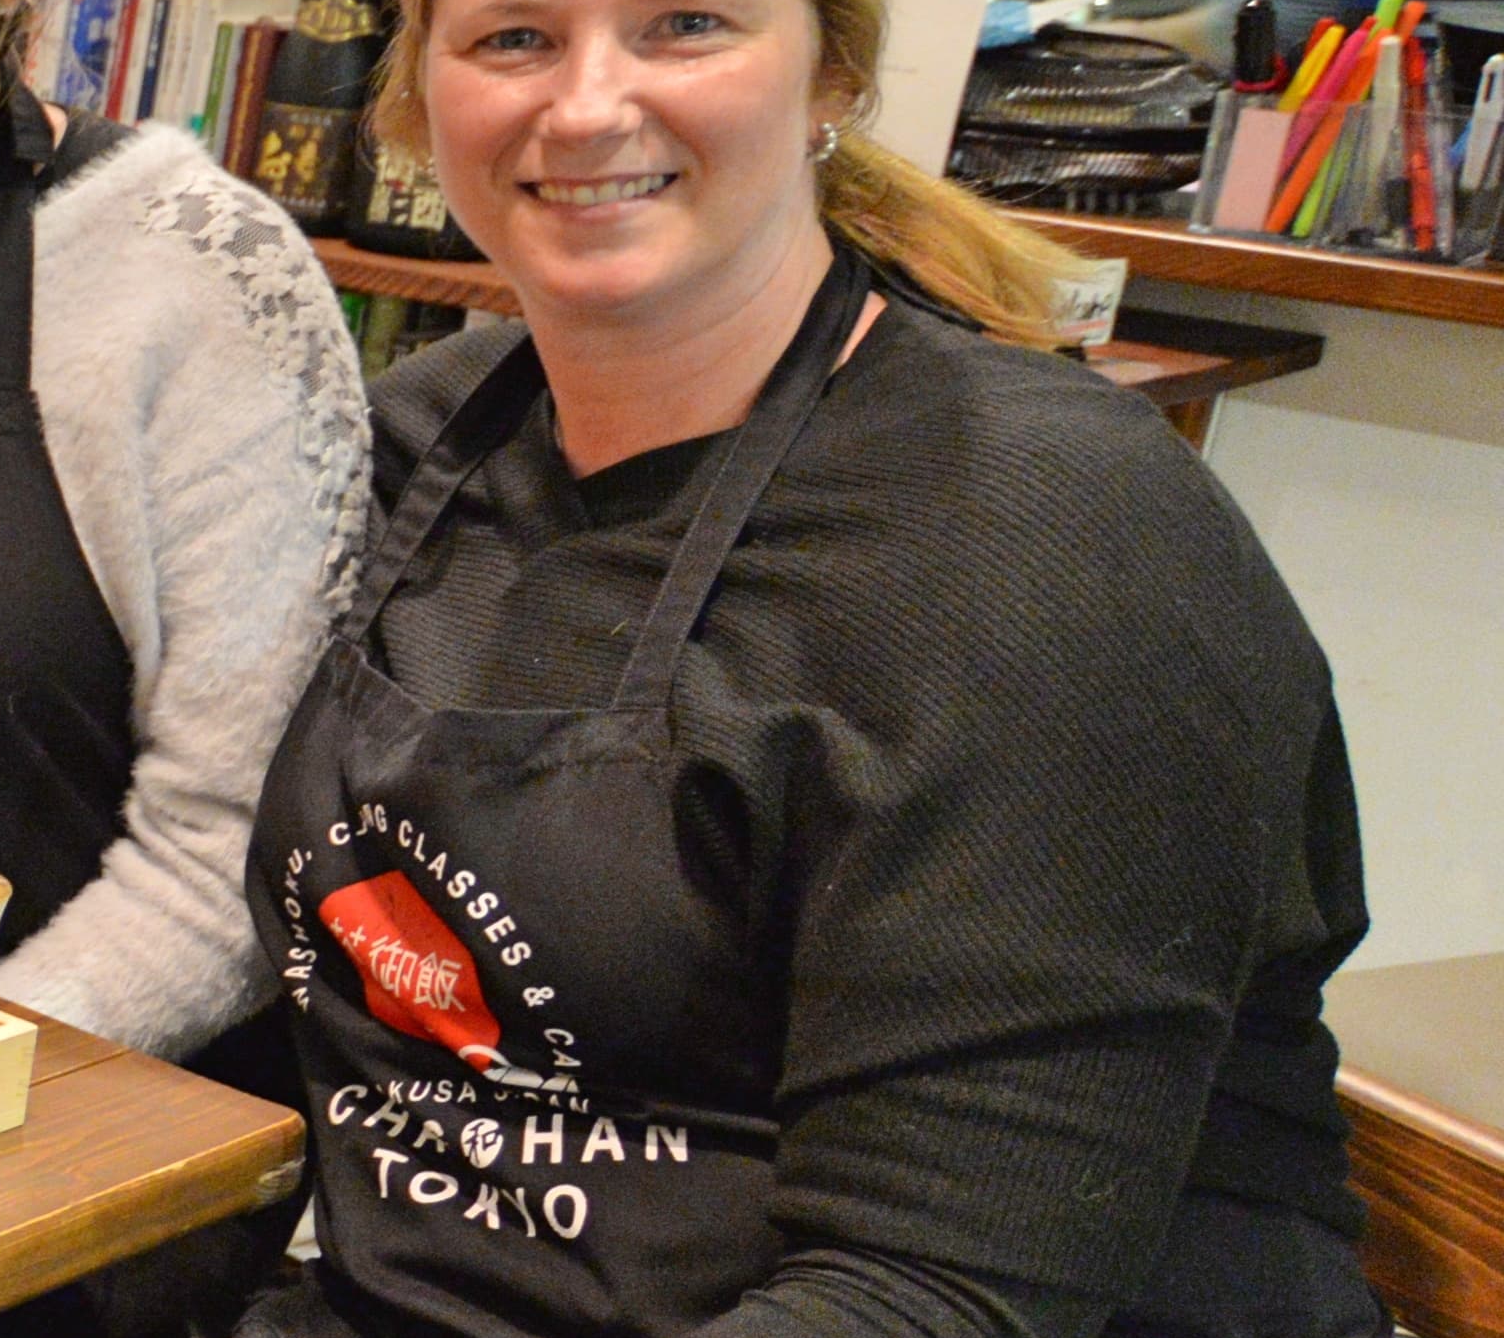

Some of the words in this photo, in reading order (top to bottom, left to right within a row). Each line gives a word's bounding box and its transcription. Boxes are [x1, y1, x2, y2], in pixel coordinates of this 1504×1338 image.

[398, 819, 532, 966] CLASSES
[522, 987, 555, 1007] &
[371, 1147, 588, 1240] TOKYO
